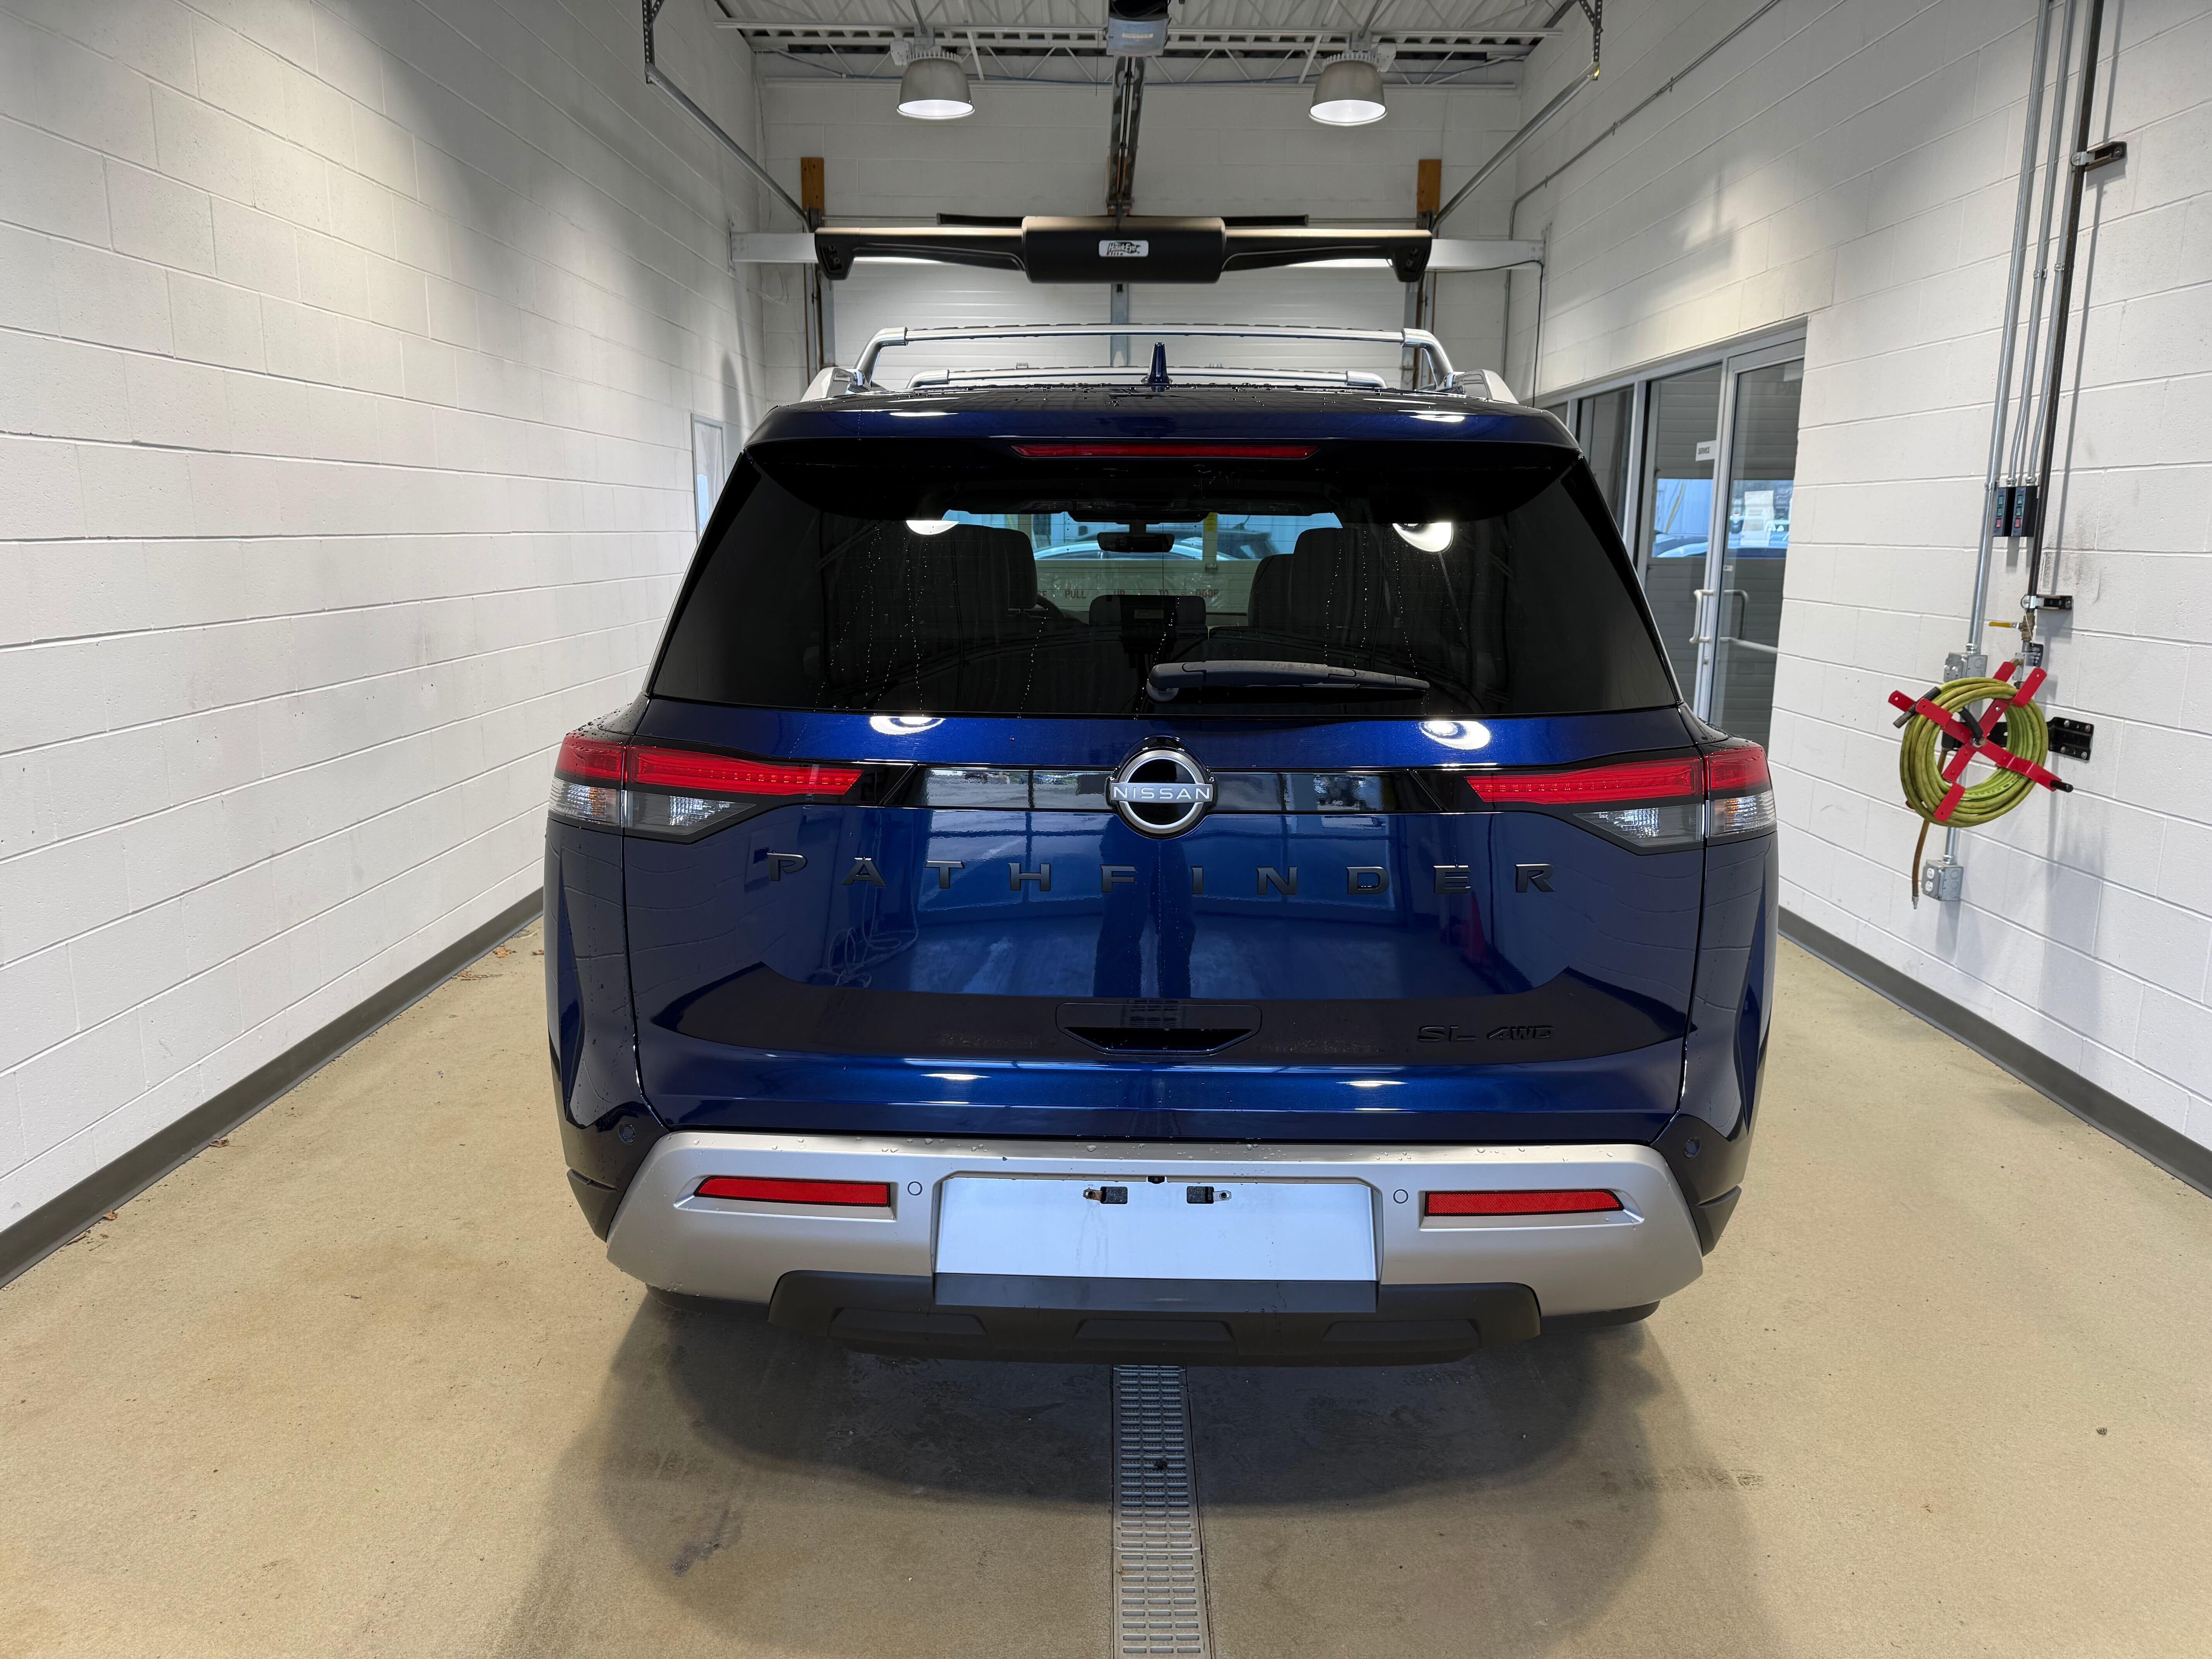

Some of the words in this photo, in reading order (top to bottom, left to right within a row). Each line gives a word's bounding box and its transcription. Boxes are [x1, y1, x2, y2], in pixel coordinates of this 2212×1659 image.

[1065, 589, 1086, 598] PULL
[1113, 786, 1210, 800] NISSAN
[767, 852, 1555, 895] PATHFINDER
[1417, 1025, 1477, 1042] SL
[1486, 1025, 1555, 1040] 4WD
